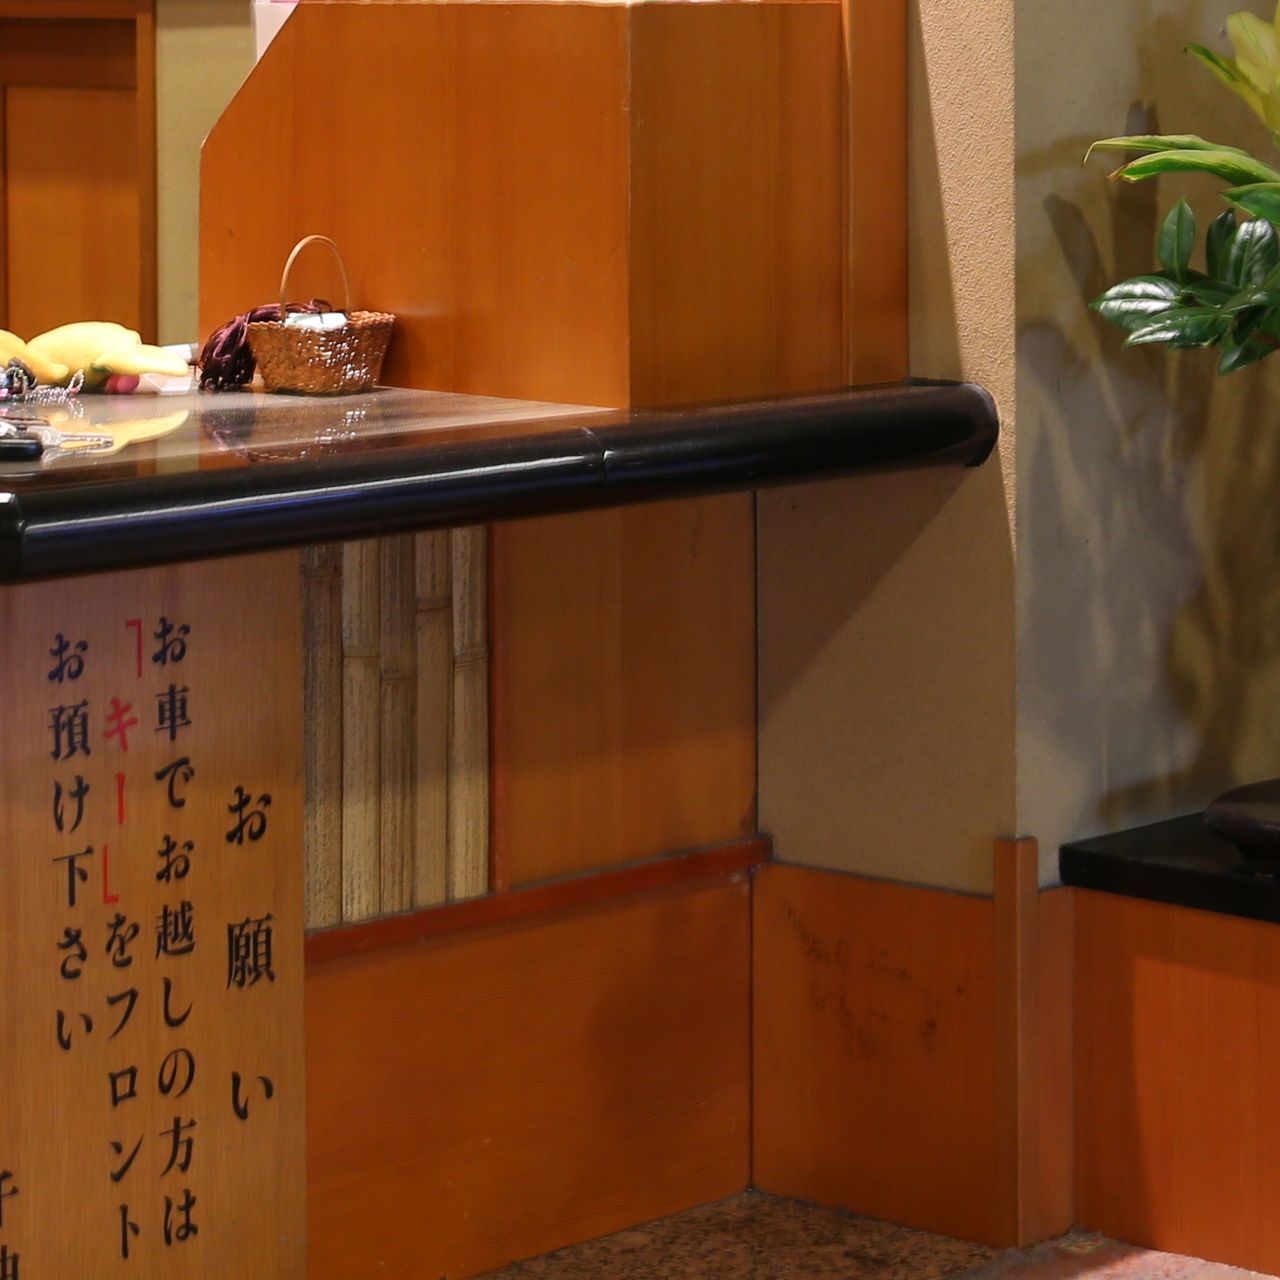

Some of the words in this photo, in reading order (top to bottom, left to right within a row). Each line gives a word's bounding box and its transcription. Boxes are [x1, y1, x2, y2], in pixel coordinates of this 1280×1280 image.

[47, 632, 94, 1051] お預け下さい
[151, 615, 199, 1247] お車でお越しの方は
[225, 785, 276, 1122] お願い
